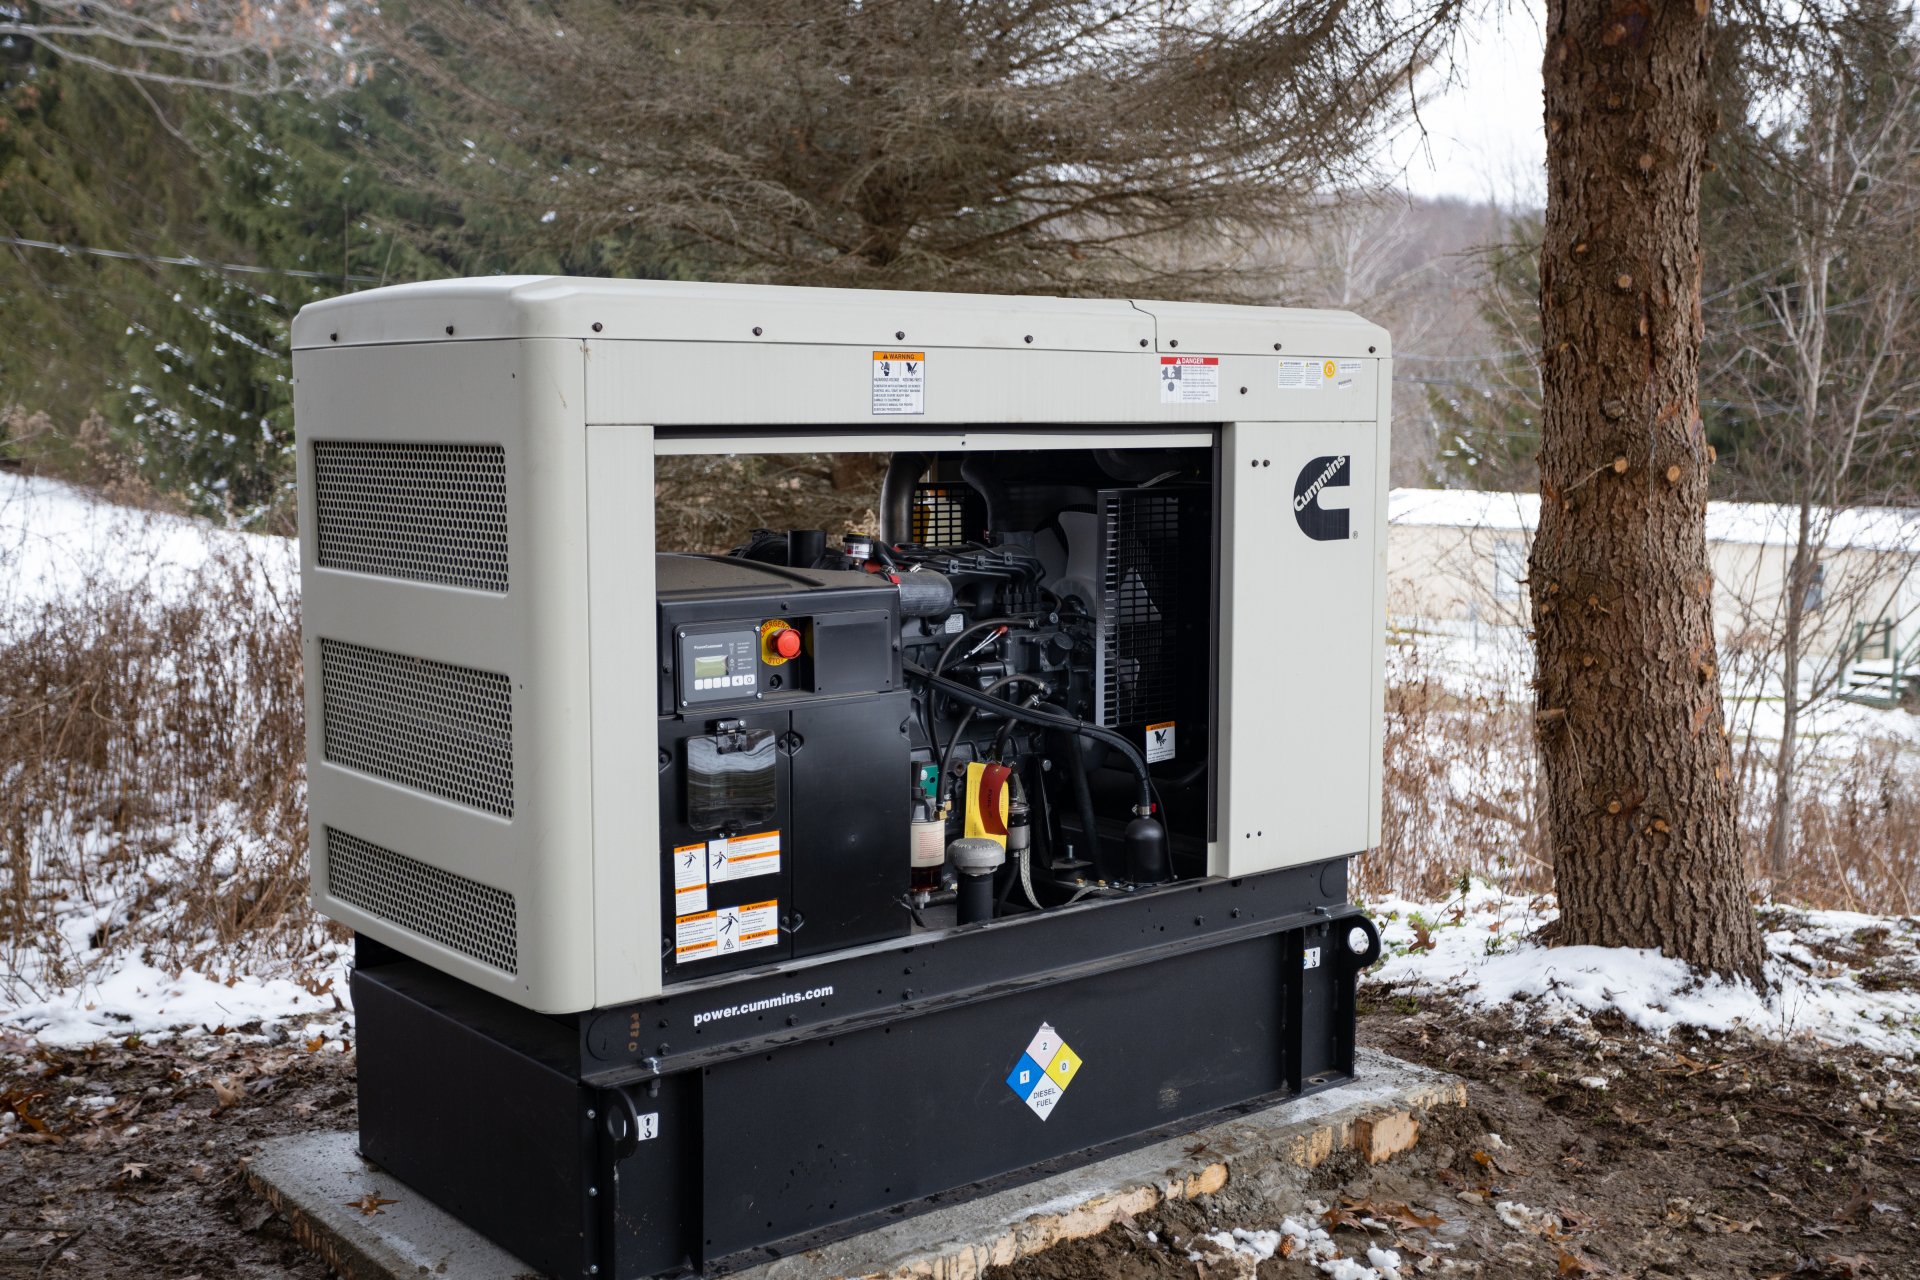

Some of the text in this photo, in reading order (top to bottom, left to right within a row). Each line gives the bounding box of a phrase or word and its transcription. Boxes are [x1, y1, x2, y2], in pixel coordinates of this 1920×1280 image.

[1181, 357, 1204, 365] DANGER
[1294, 455, 1346, 512] Cummins
[761, 620, 790, 637] MERGENC
[694, 985, 833, 1026] power.cummins.com
[1042, 1042, 1047, 1051] 2
[1061, 1062, 1066, 1071] 0
[1033, 1088, 1056, 1099] DIESEL
[1036, 1098, 1052, 1108] FUEL
